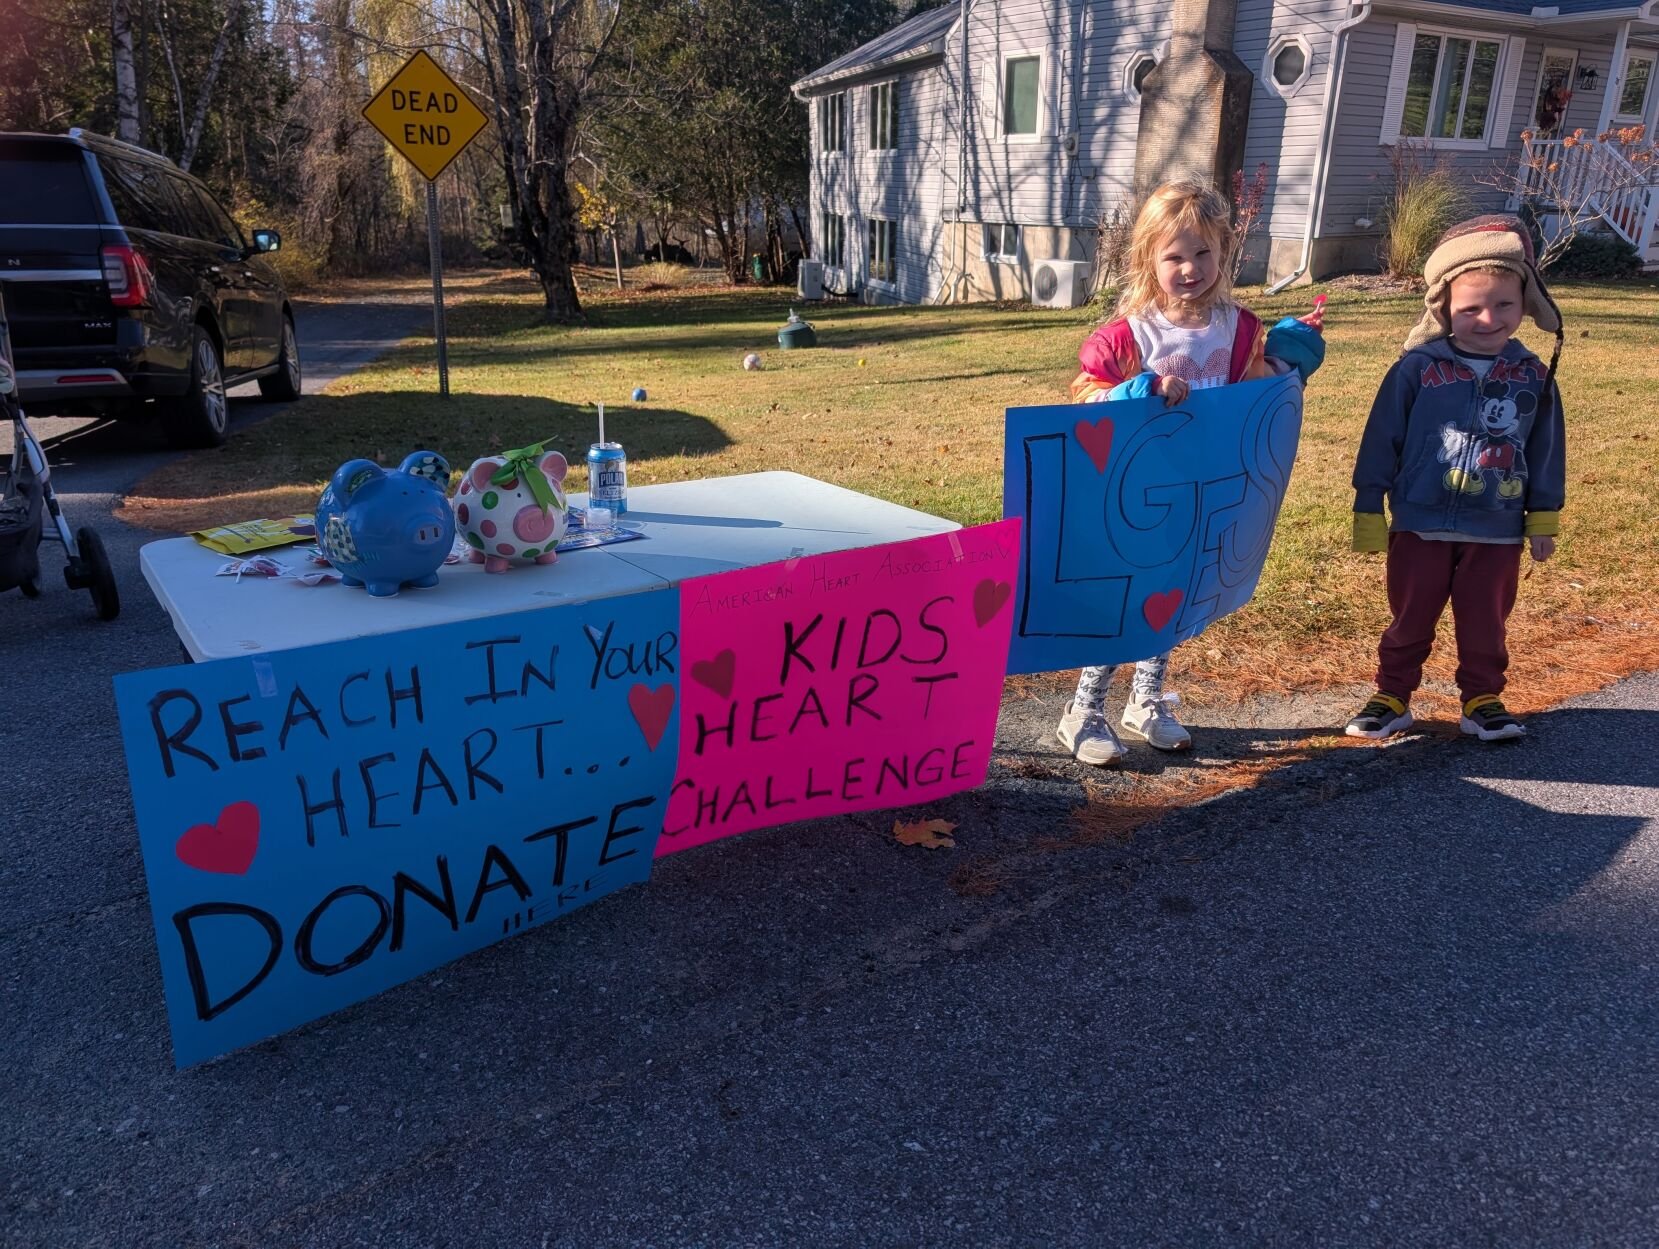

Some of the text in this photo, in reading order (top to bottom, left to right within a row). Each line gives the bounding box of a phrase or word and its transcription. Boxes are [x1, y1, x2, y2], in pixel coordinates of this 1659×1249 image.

[391, 89, 458, 114] DEAD
[403, 123, 451, 146] END
[690, 551, 994, 617] AMERICAN HEART ASSOCIATION
[779, 596, 955, 687] KIDS
[148, 621, 679, 778] REACH IN YOUR
[694, 671, 959, 756] HEART
[661, 740, 975, 837] CHALLENGE
[172, 795, 657, 1022] DONATE
